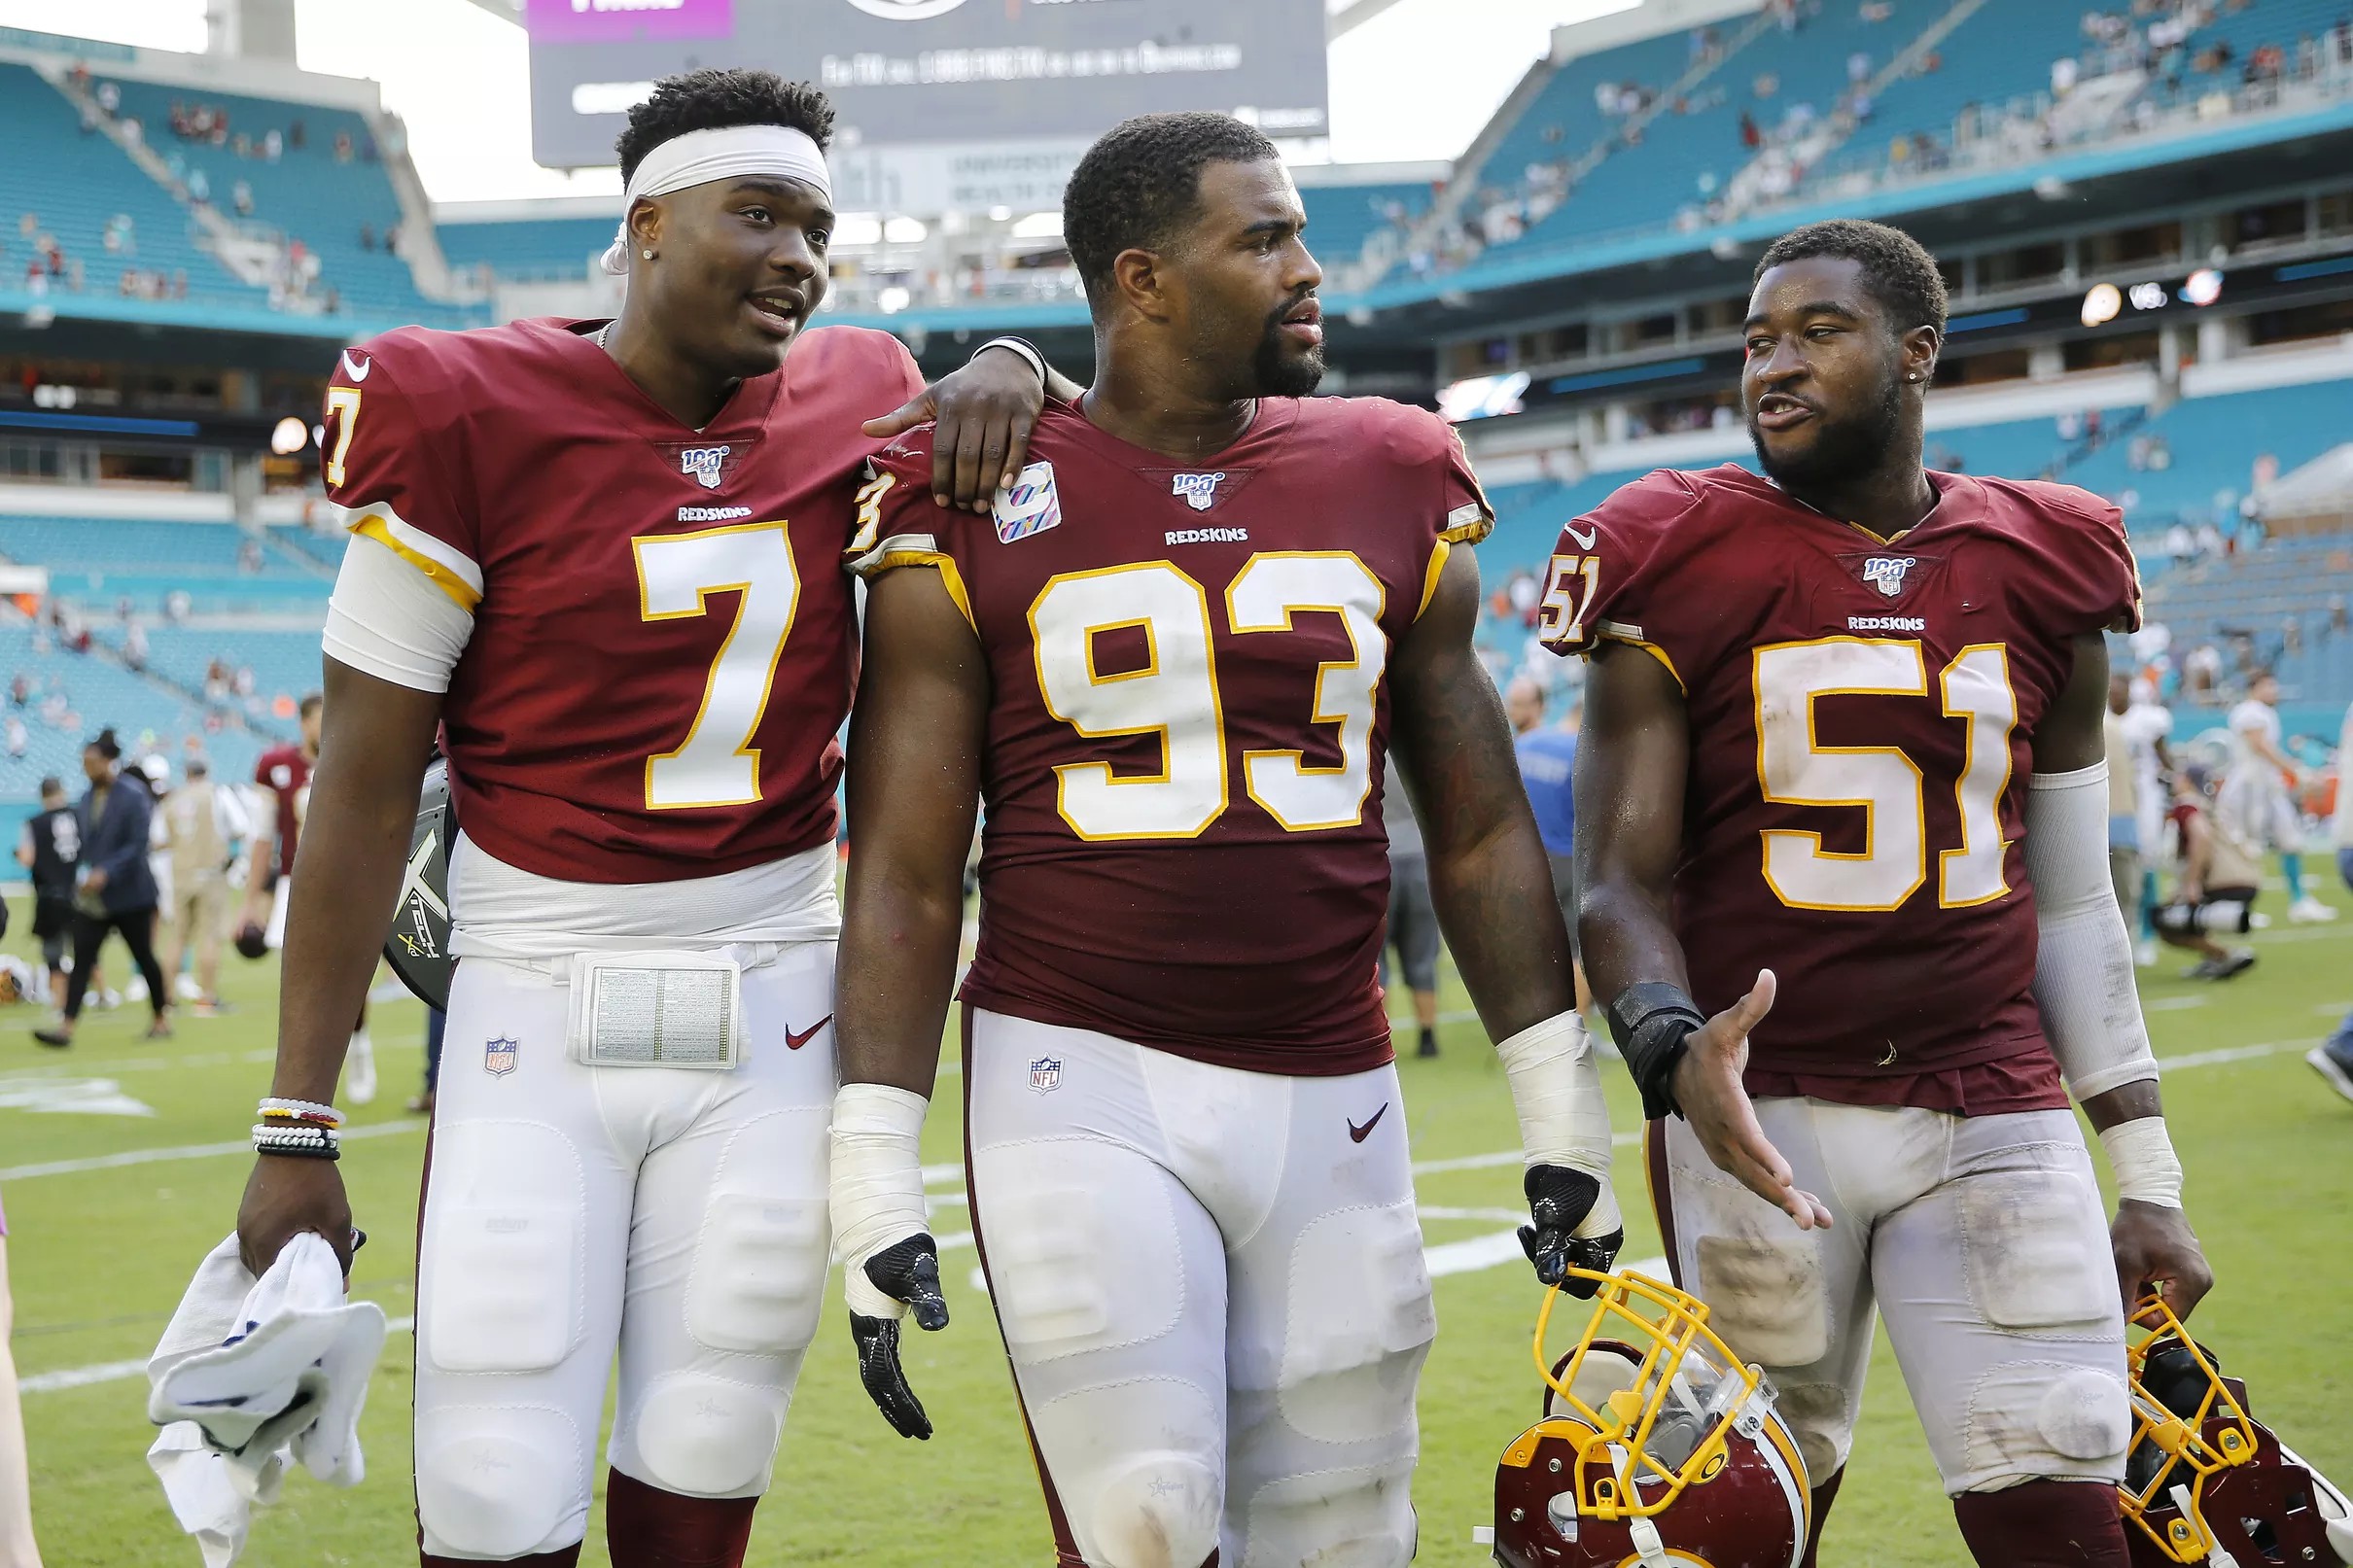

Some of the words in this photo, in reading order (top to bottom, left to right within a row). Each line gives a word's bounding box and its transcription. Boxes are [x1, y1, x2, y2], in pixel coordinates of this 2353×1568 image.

[326, 386, 362, 488] 7
[678, 506, 753, 522] REDSKINS
[1165, 528, 1248, 546] REDSKINS
[1539, 554, 1600, 645] 51
[1847, 616, 1925, 631] REDSKINS
[631, 519, 801, 811] 7
[1027, 549, 1387, 842] 93
[1752, 635, 2019, 912] 51
[488, 1053, 512, 1071] NFL
[1032, 1071, 1056, 1087] NFL
